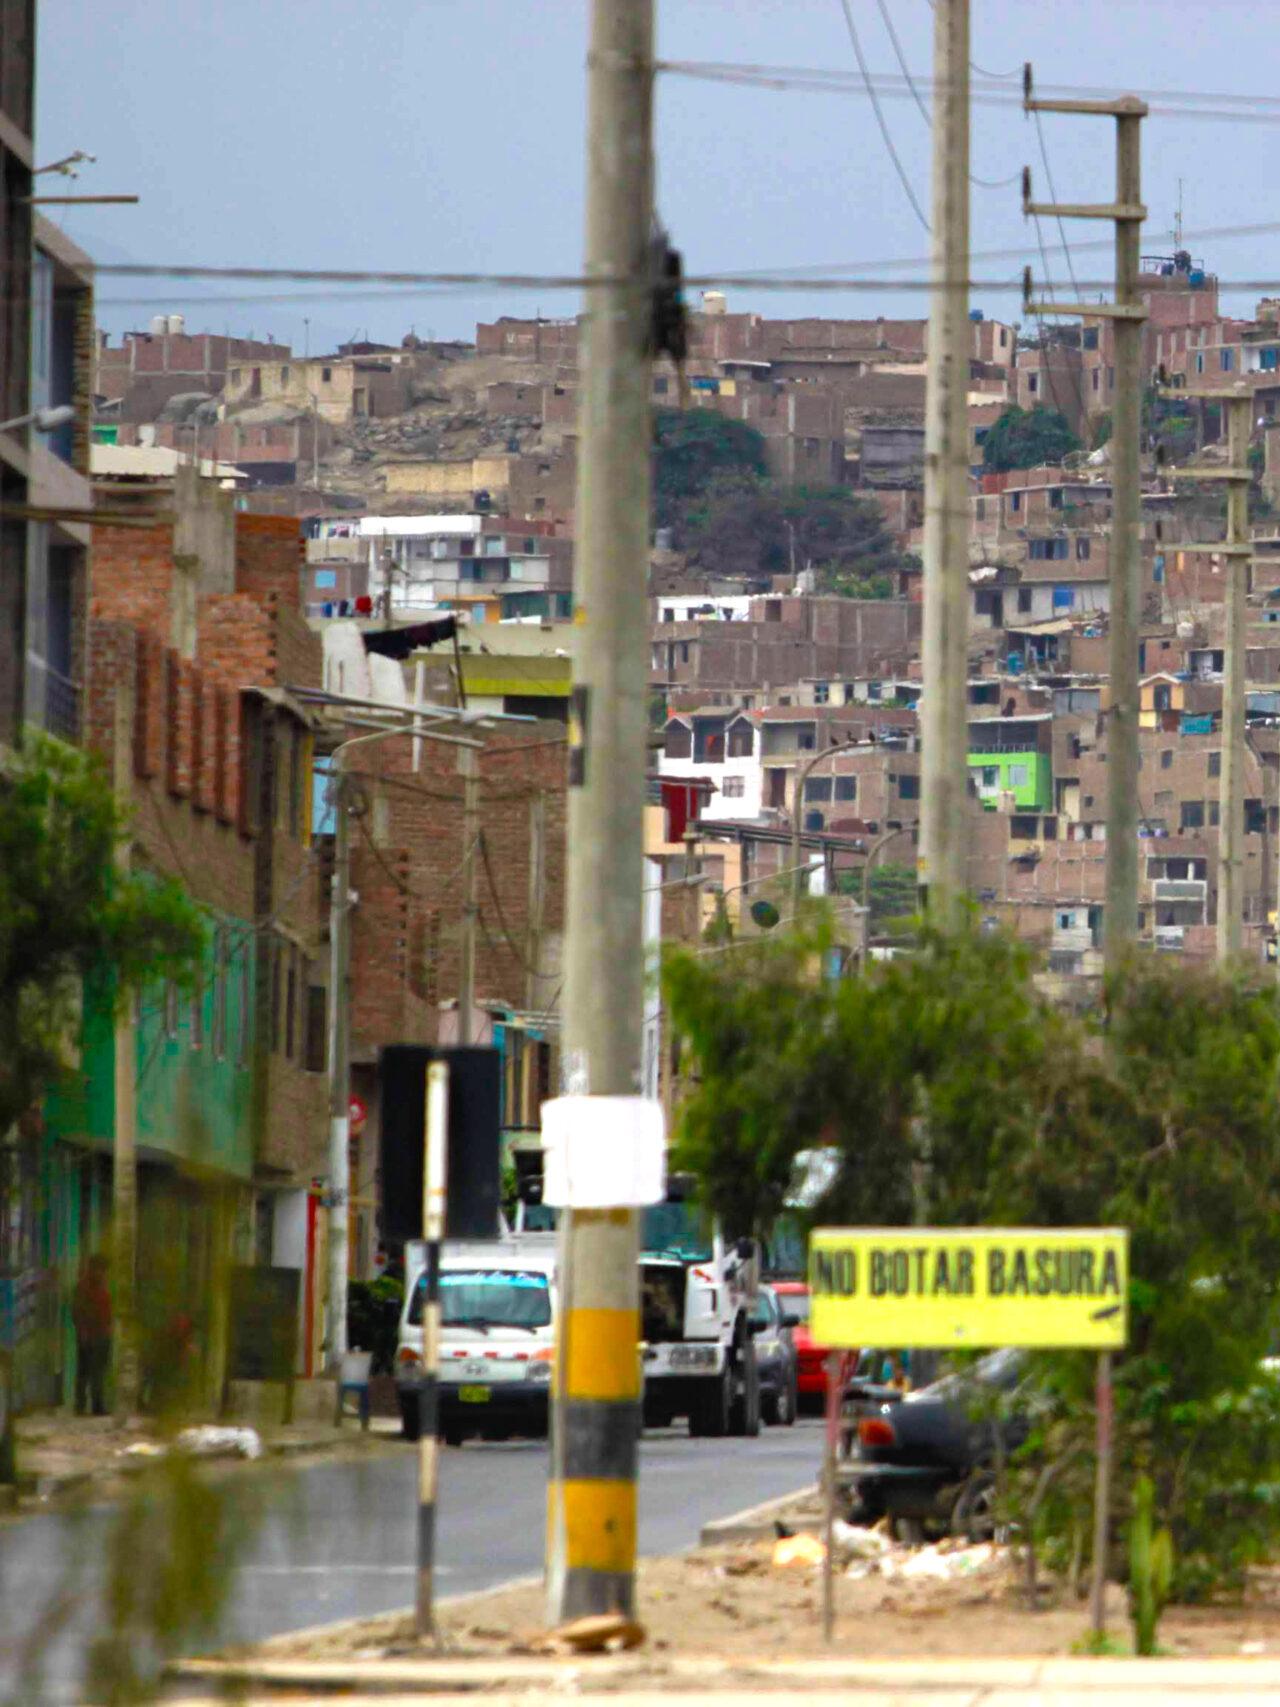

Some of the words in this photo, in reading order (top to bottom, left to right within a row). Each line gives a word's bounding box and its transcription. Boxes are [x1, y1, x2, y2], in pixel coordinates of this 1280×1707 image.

[814, 1249, 857, 1297] NO
[869, 1248, 975, 1297] BOTAR
[986, 1246, 1121, 1297] BASURA
